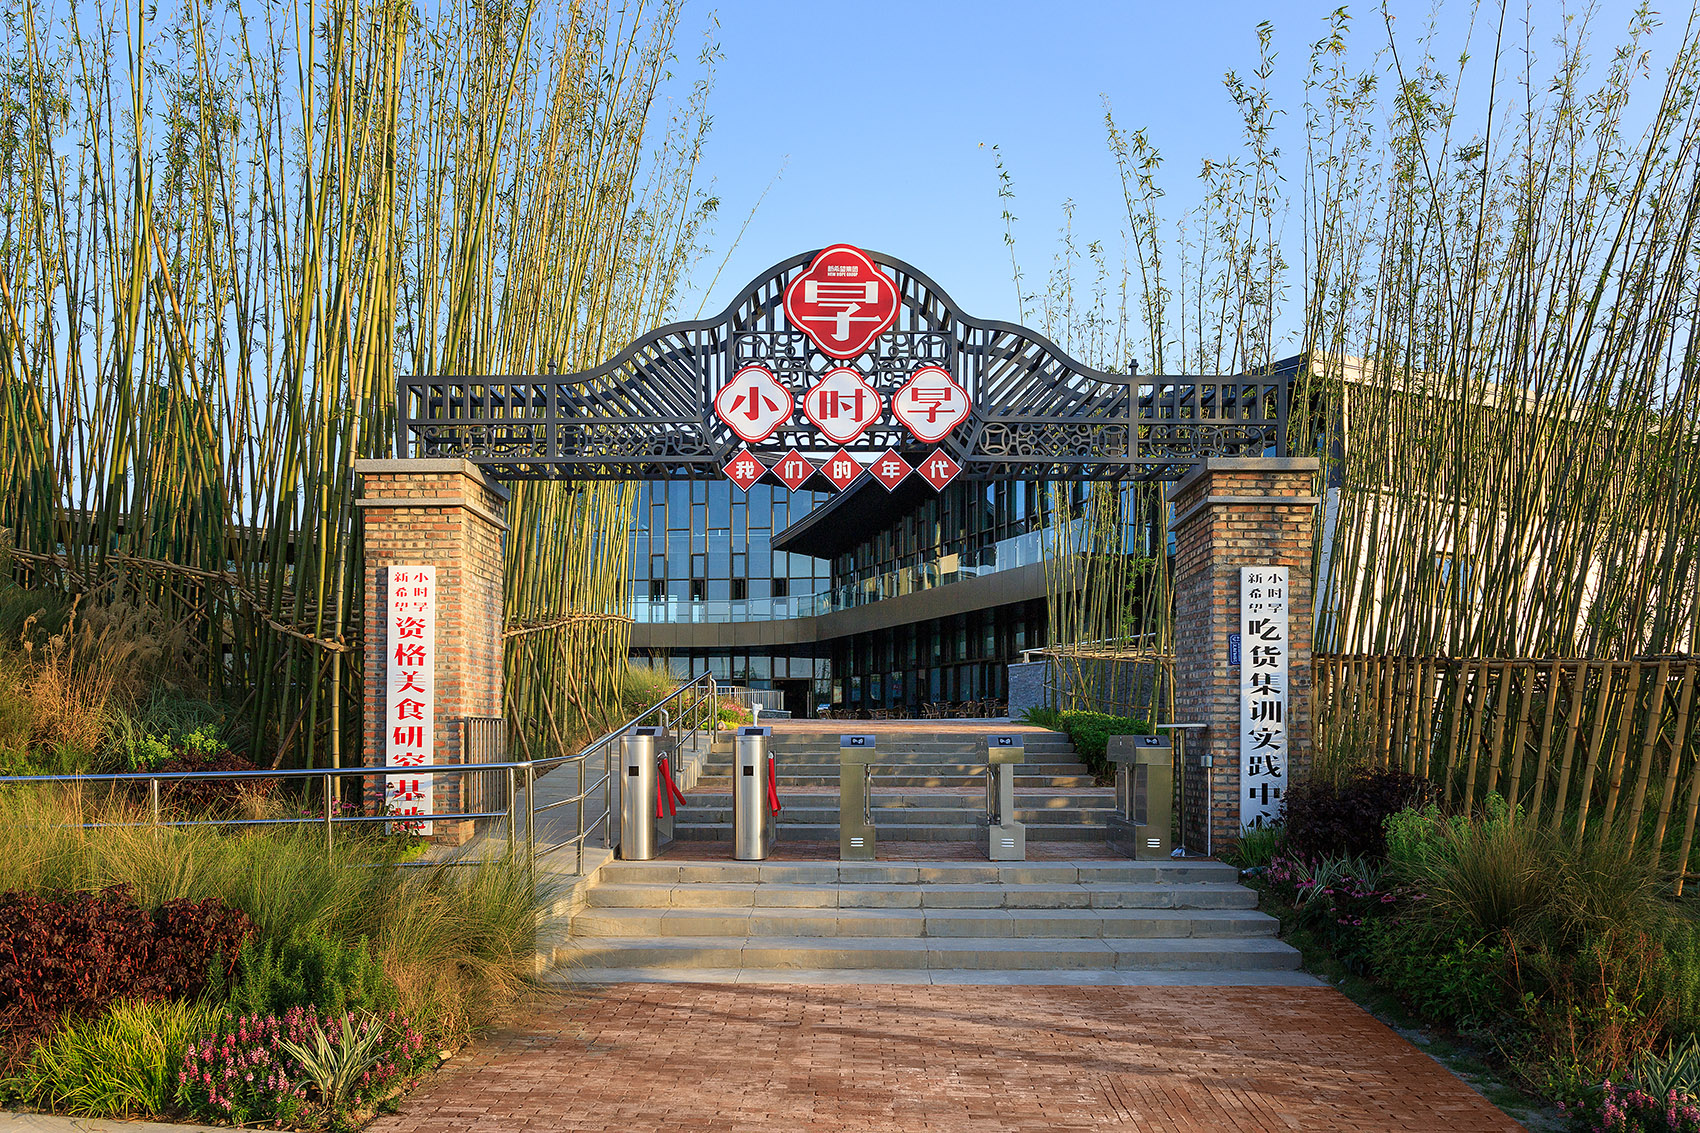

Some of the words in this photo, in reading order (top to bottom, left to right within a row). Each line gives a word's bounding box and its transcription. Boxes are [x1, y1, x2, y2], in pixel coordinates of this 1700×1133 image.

[735, 461, 949, 480] 我们的年代
[394, 571, 408, 612] 新希望
[1248, 573, 1262, 613] 新希望
